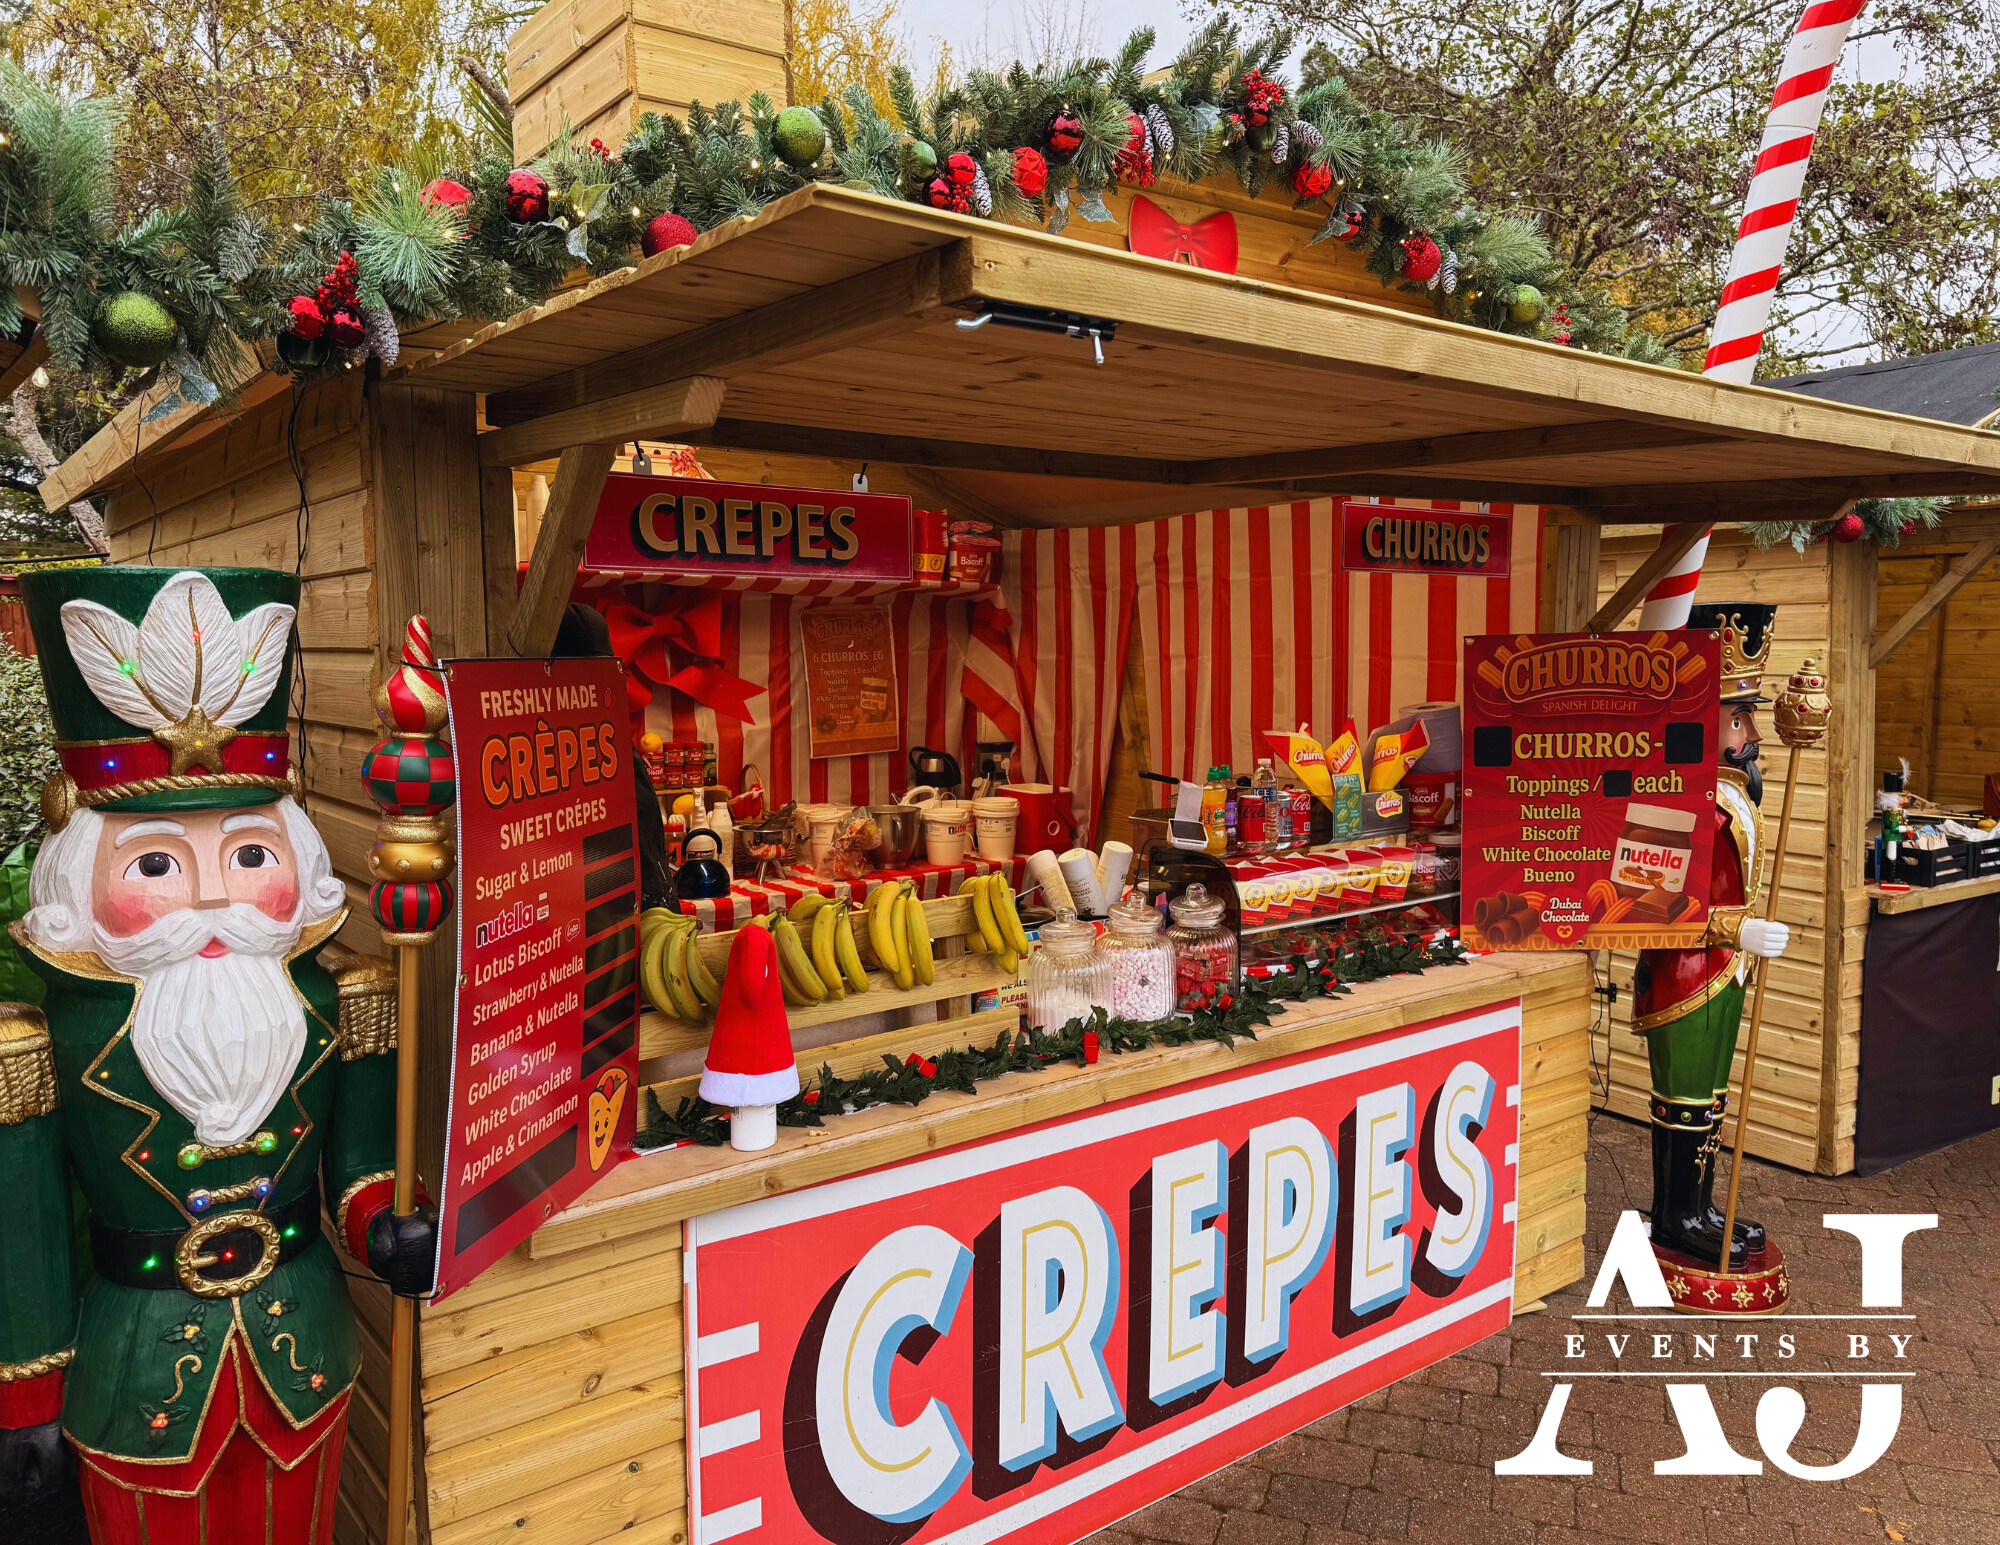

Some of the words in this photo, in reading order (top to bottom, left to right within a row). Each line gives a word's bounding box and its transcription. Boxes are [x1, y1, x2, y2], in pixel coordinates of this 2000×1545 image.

[634, 493, 860, 564] CREPES
[1364, 516, 1490, 566] CHURROS
[960, 556, 984, 566] Biscoff
[816, 620, 873, 639] CHURROS
[813, 653, 819, 663] 6
[1508, 645, 1671, 697] CHURROS
[480, 688, 551, 718] FRESHLY
[556, 684, 597, 711] MADE
[1542, 700, 1588, 713] SPANISH
[1591, 699, 1639, 713] DELIGHT
[1331, 741, 1356, 774] Churros
[1506, 774, 1590, 798] Toppings
[1633, 769, 1684, 794] each
[1376, 797, 1402, 810] Churros
[1520, 803, 1582, 820] Nutella
[500, 813, 552, 851] SWEET
[948, 825, 966, 835] nute
[1521, 825, 1580, 842] Biscoff
[1418, 865, 1436, 874] Bisco
[1482, 847, 1531, 862] White
[1533, 846, 1611, 862] Chocolate
[1620, 847, 1683, 870] nutella
[476, 871, 517, 901] Sugar
[520, 861, 530, 884] &
[533, 851, 573, 878] Lemon
[1523, 868, 1575, 883] Bueno
[1540, 910, 1590, 924] Chocolate
[1549, 897, 1582, 910] Dubai
[476, 901, 534, 949] nutella
[474, 955, 514, 987] Lotus
[518, 927, 562, 967] Biscoff
[473, 986, 538, 1026] Strawberry
[539, 972, 548, 991] &
[549, 955, 584, 986] Nutella
[470, 1031, 523, 1067] Banana
[525, 1010, 534, 1034] &
[537, 992, 579, 1029] Nutella
[468, 1065, 518, 1106] Golden
[520, 1041, 557, 1077] Syrup
[465, 1107, 508, 1146] White
[510, 1065, 572, 1117] Chocolate
[460, 1146, 503, 1187] Apple
[505, 1134, 515, 1156] &
[517, 1094, 579, 1147] Cinnamon
[792, 1060, 1496, 1538] CREPES
